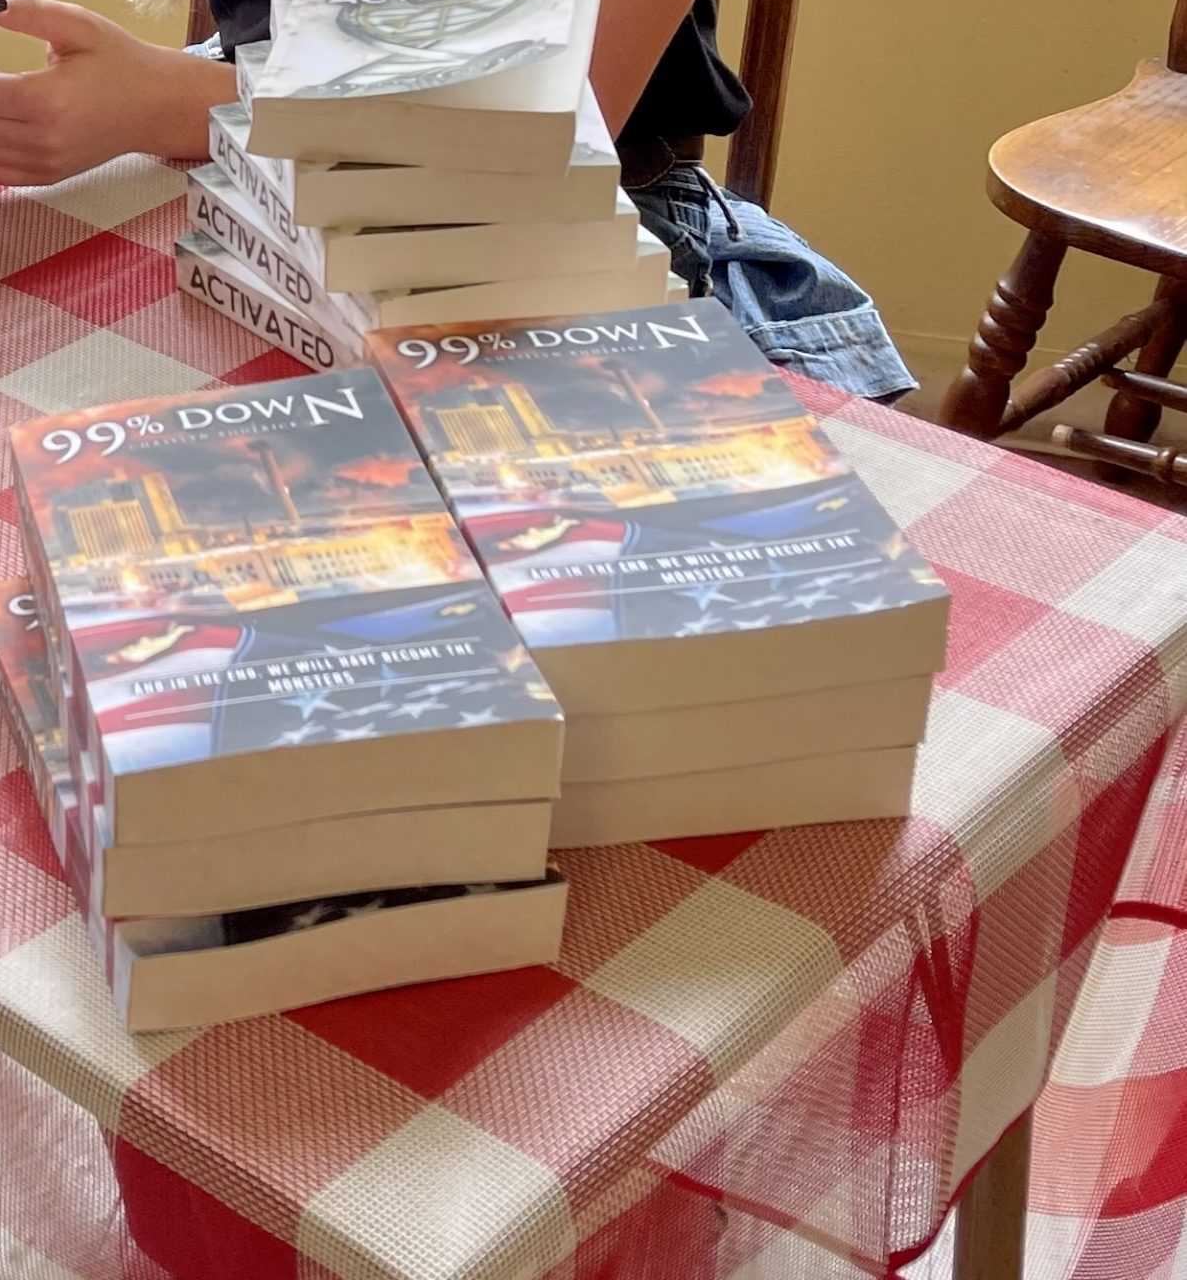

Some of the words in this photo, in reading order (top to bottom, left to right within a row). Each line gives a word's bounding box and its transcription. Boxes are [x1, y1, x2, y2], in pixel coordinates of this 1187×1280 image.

[196, 193, 314, 306] ACTIVATED
[190, 263, 336, 371] ACTIVATED
[396, 330, 518, 371] 99%
[526, 313, 712, 351] DOWN
[41, 412, 166, 465] 99%
[178, 387, 366, 433] DOWN
[530, 567, 560, 582] AND
[565, 565, 584, 578] IN
[588, 562, 614, 577] THE
[655, 555, 681, 570] WE
[683, 551, 722, 567] WILL
[725, 547, 765, 563] HAVE
[765, 541, 825, 561] BECOME
[827, 535, 858, 550] THE
[660, 563, 746, 585] MONSTERS
[132, 681, 164, 697] AND
[169, 678, 188, 693] IN
[193, 674, 222, 690] THE
[267, 663, 292, 678] WE
[296, 658, 334, 674] WILL
[338, 653, 377, 669] HAVE
[380, 647, 442, 665] BECOME
[445, 642, 476, 657] THE
[267, 670, 356, 695] MONSTERS
